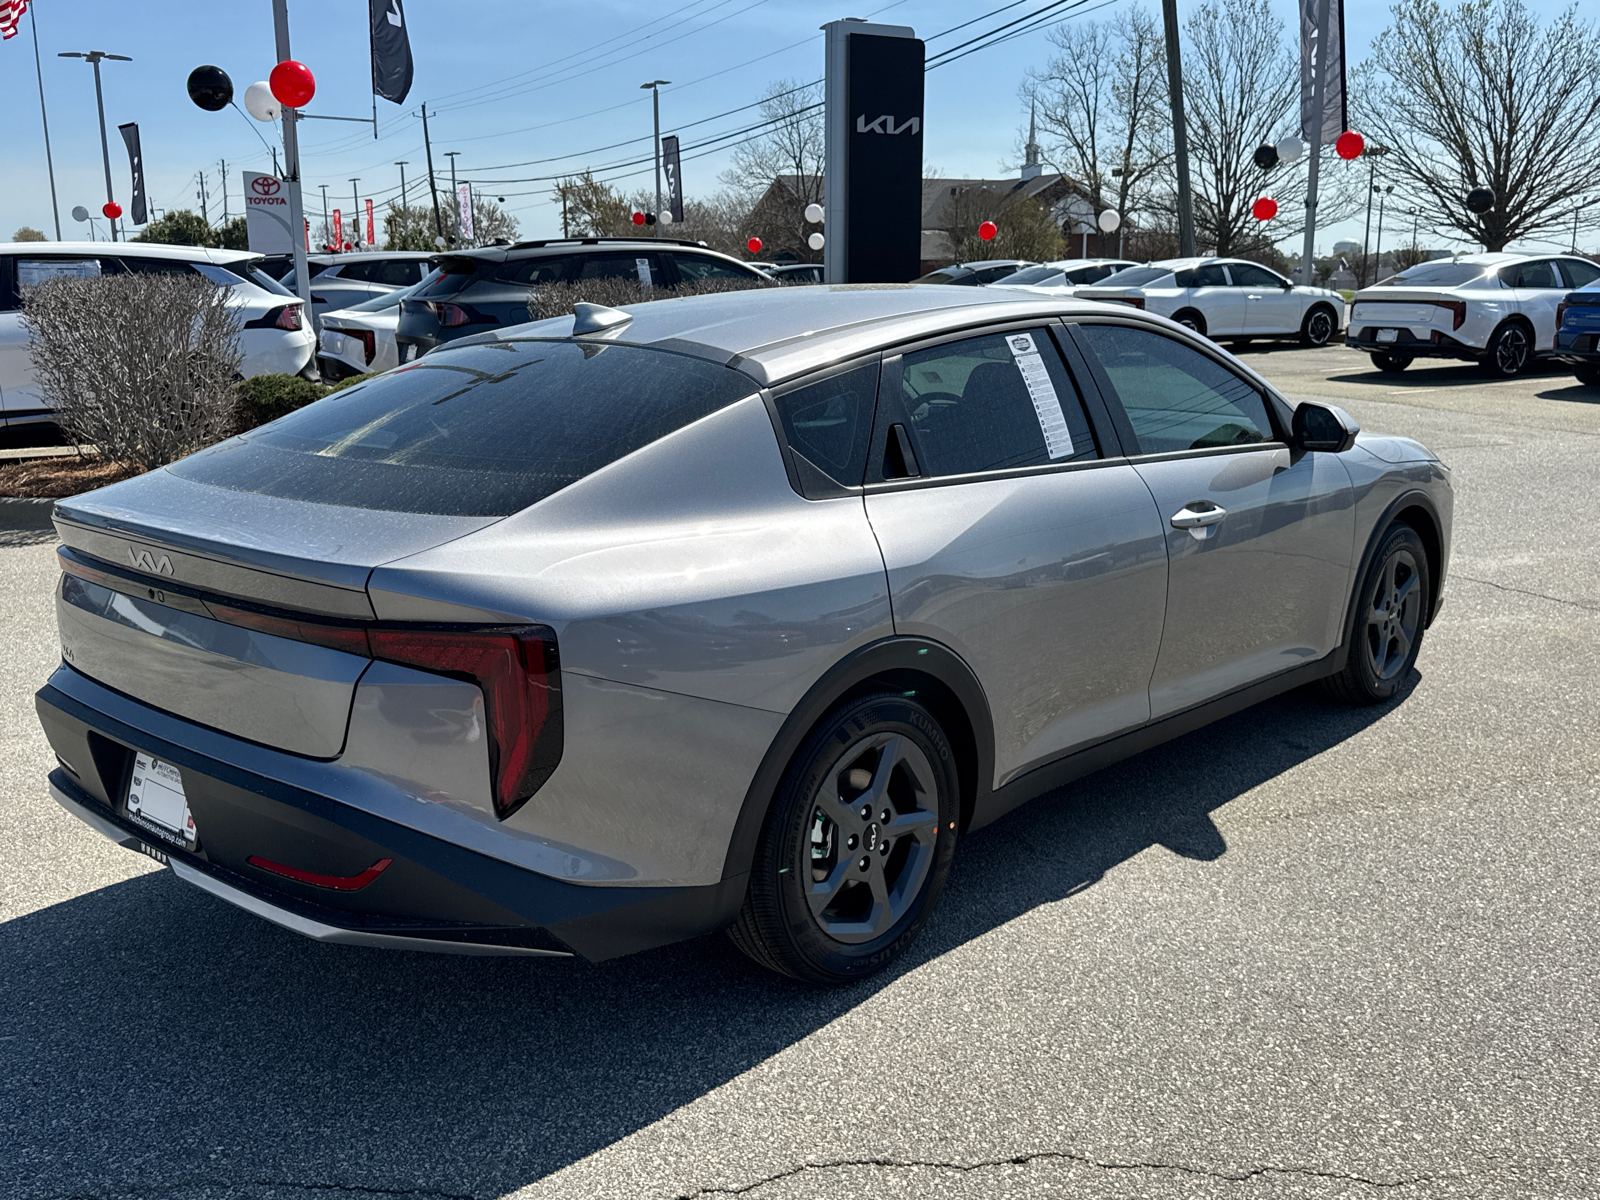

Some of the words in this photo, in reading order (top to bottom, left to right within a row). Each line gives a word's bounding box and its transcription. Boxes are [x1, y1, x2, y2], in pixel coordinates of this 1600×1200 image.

[857, 114, 919, 135] KIA
[247, 197, 287, 205] TOYOTA
[128, 546, 175, 576] KIA
[909, 710, 949, 761] KUMHO
[157, 762, 180, 778] HUTCHINS
[870, 919, 920, 967] SOLUS
